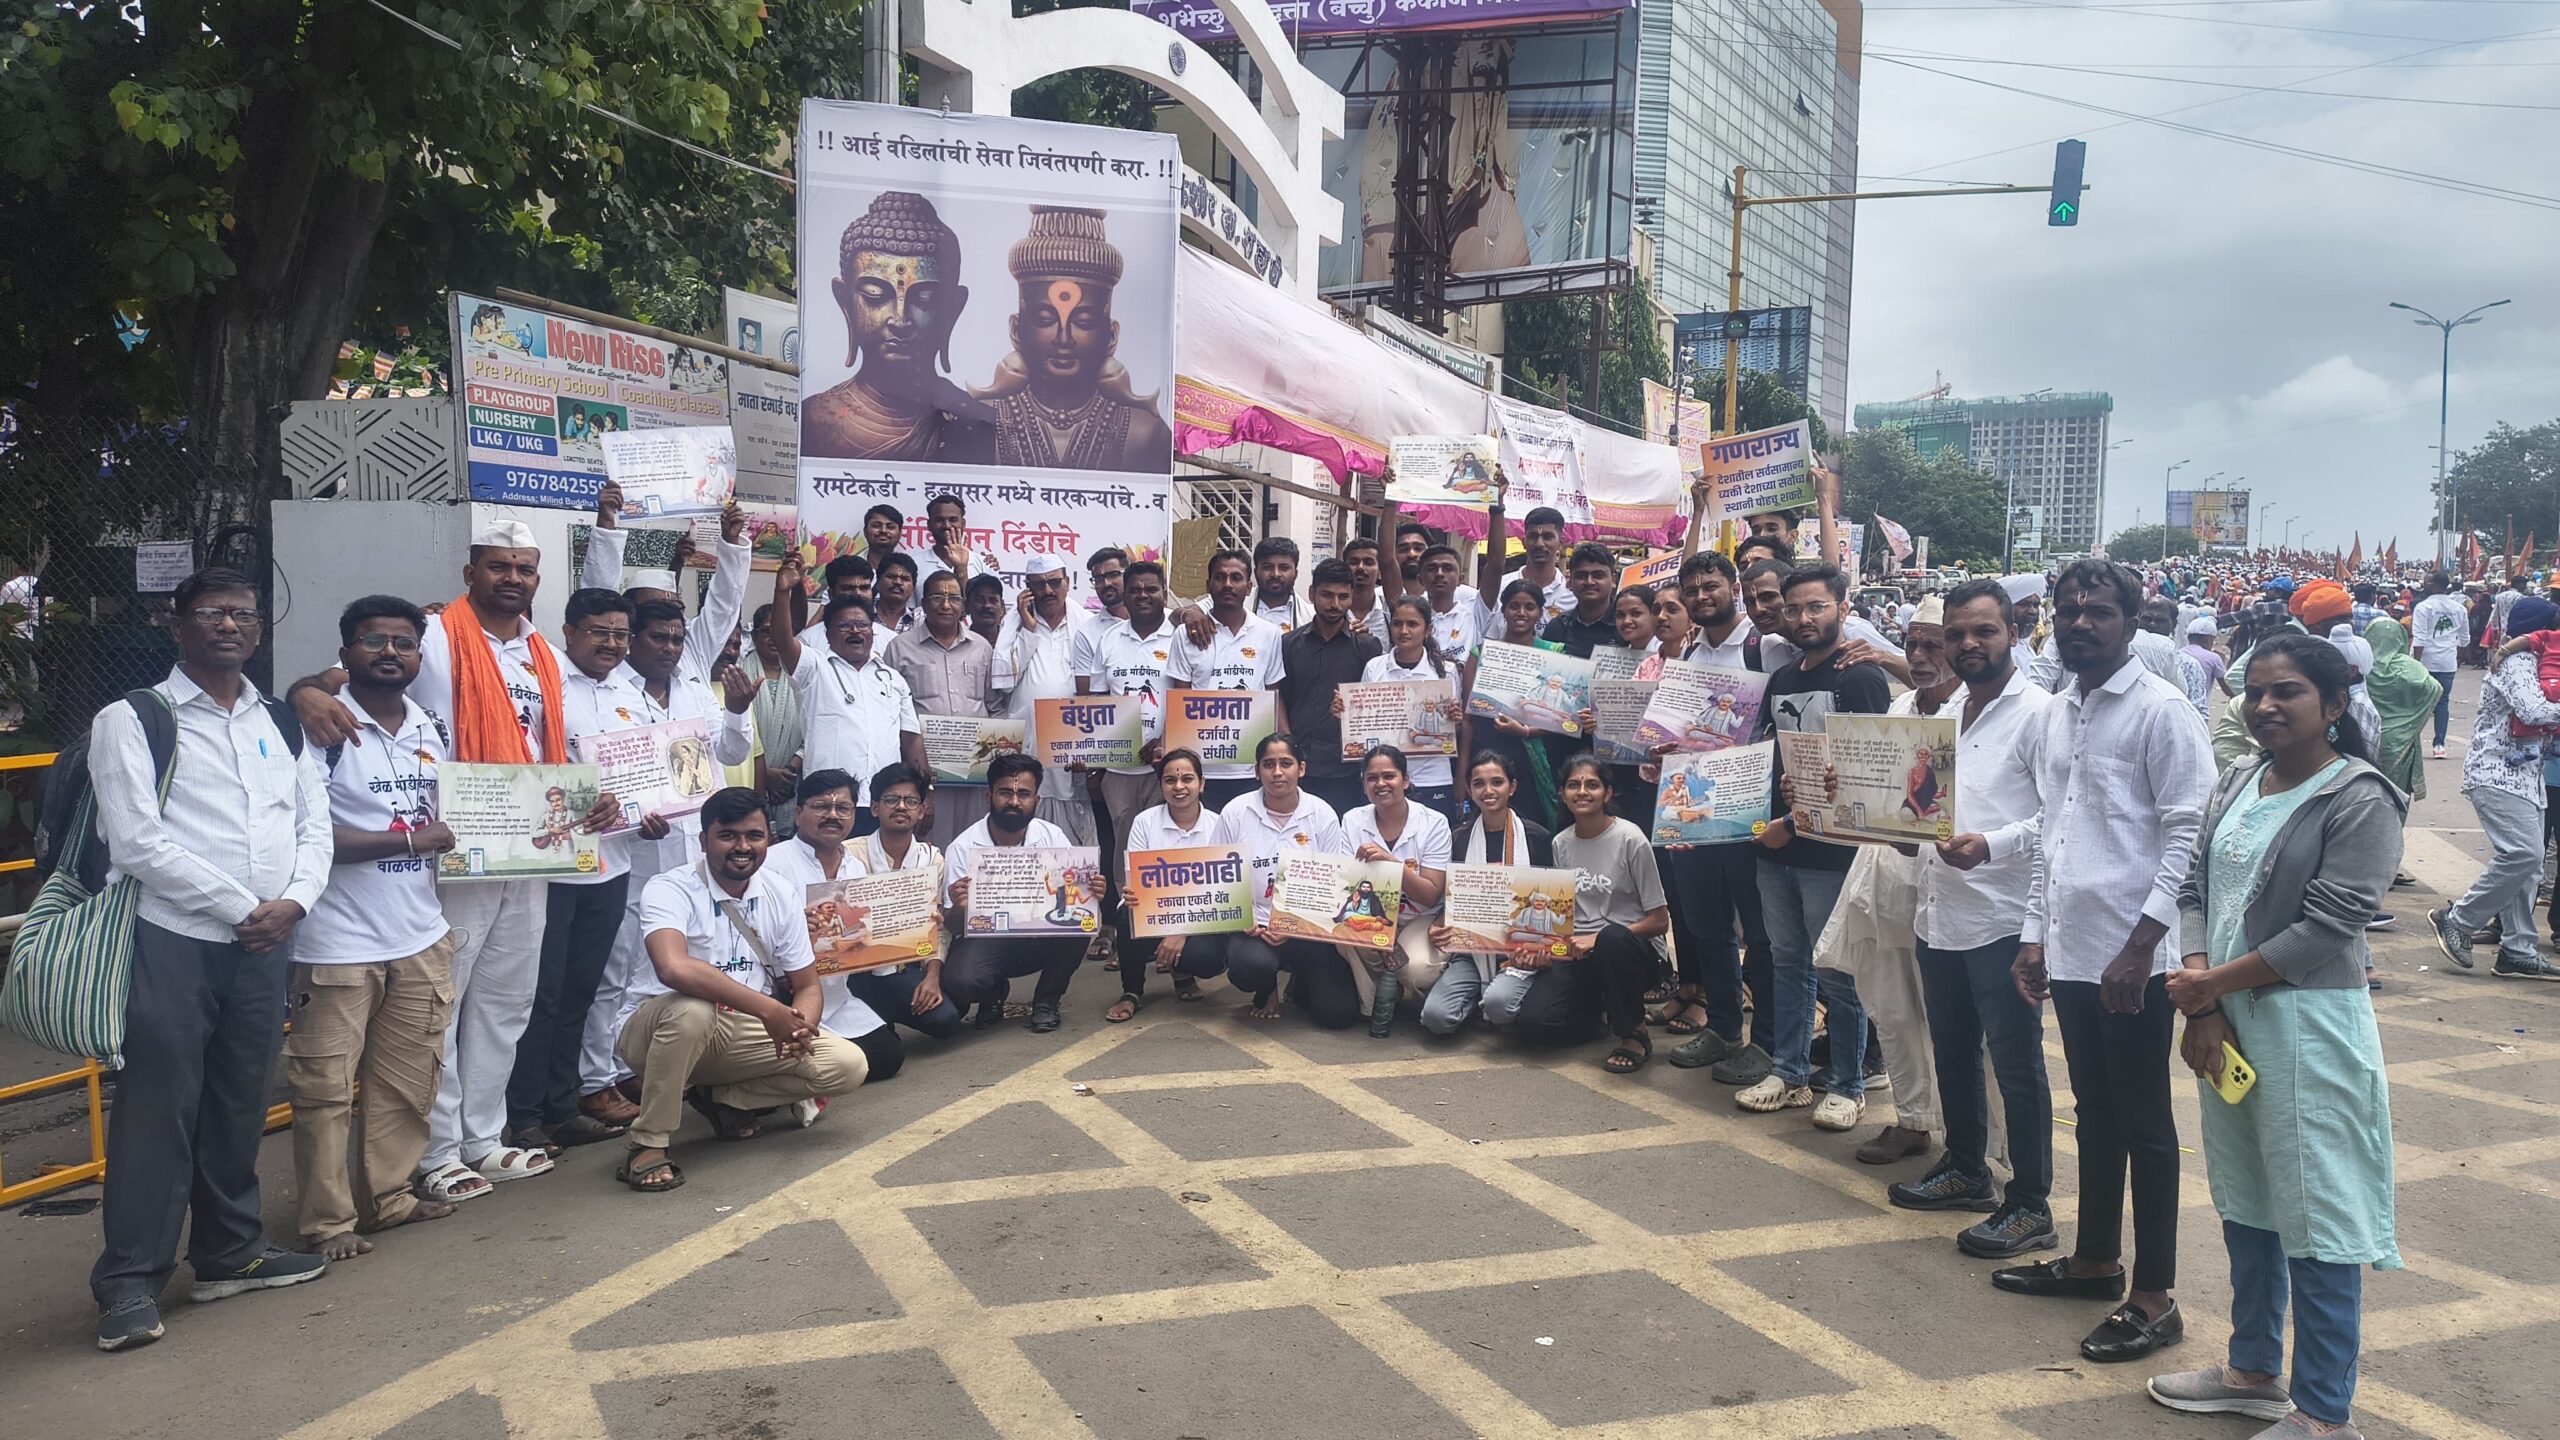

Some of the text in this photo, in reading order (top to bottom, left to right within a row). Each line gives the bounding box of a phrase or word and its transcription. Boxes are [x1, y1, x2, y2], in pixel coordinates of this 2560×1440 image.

[842, 132, 882, 161] आई
[887, 134, 972, 165] वडिलांची
[976, 141, 1014, 168] सेवा
[1018, 144, 1106, 175] जिवंतपणी
[1111, 158, 1150, 180] करा.
[546, 319, 665, 378] New Rise
[474, 360, 609, 398] Pre Primary School
[473, 387, 551, 412] PLAYGROUP
[621, 386, 721, 415] Coaching Classes
[737, 392, 759, 410] माता
[760, 396, 783, 415] रमाई
[475, 408, 537, 430] NURSERY
[476, 430, 503, 446] LKG
[516, 435, 544, 451] UKG
[1710, 428, 1800, 464] गणराज्य
[1717, 459, 1804, 485] देशातील सर्वसामान्य
[813, 472, 900, 498] रामटेकडी
[997, 480, 1036, 504] मध्ये
[1744, 480, 1776, 495] देशाच्या
[501, 491, 591, 508] Address: Milind Buddha
[1724, 497, 1754, 513] स्थानी
[899, 516, 1080, 555] संविान दिंडीचे
[1113, 664, 1160, 678] खेळ मांडीयेला
[507, 682, 544, 704] ांडीयेला
[1060, 700, 1116, 733] बंधुता
[1183, 696, 1253, 720] समता
[1050, 738, 1132, 750] एकता आणि एकात्मता
[1197, 725, 1241, 741] दर्जाची व
[1202, 744, 1237, 759] संधीची
[368, 777, 392, 794] खेळ
[1138, 852, 1243, 889] लोकशाही
[1252, 856, 1269, 869] खेळ
[1188, 891, 1212, 906] एकही
[1214, 890, 1230, 905] थेंब
[1147, 906, 1243, 925] न सांडता केलेली क्रांती
